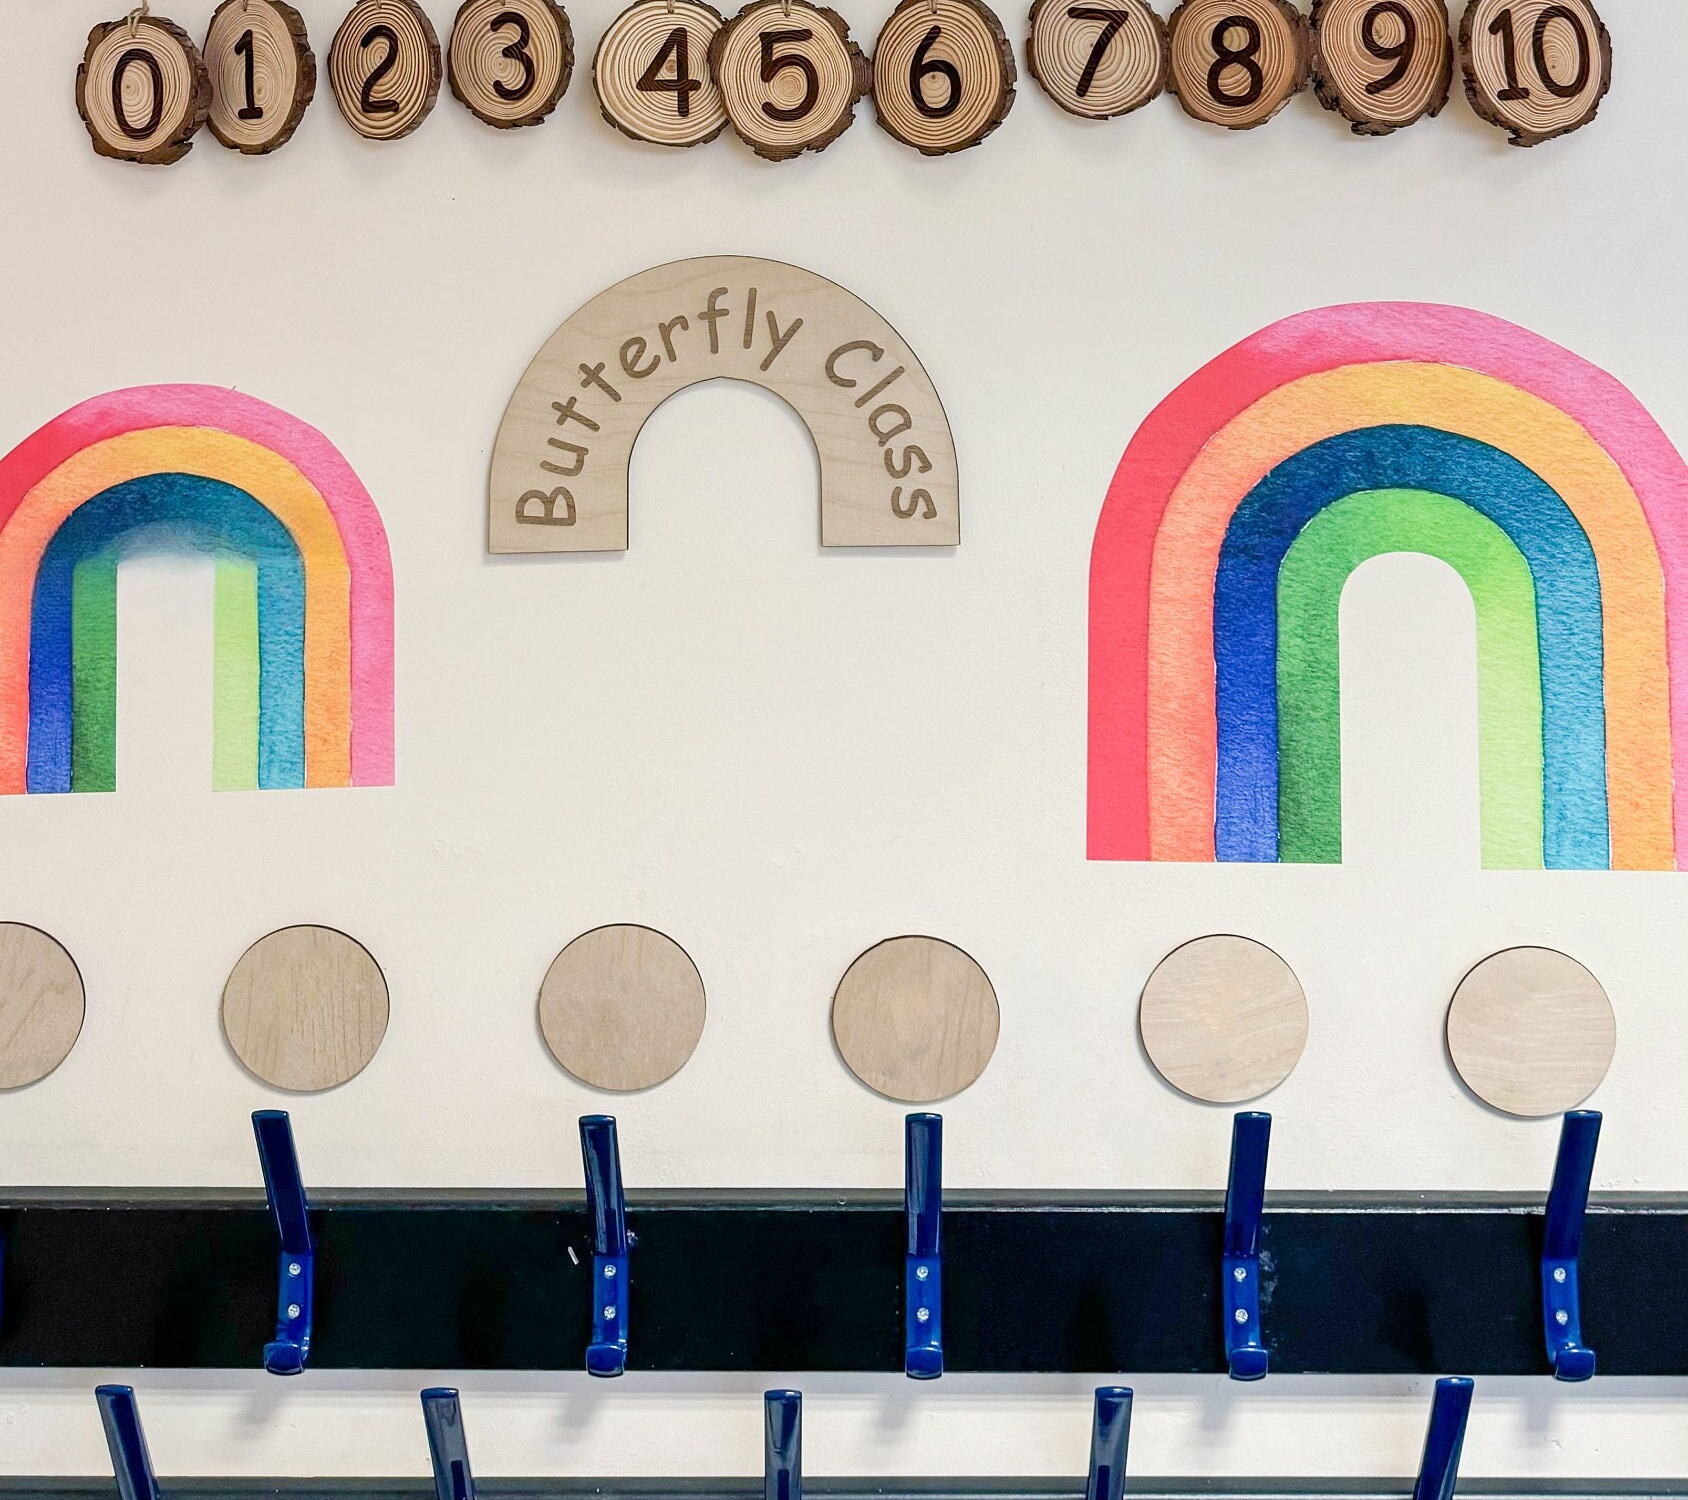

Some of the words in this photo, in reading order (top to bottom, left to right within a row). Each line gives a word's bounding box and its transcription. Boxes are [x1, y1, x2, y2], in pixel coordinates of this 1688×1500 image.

[112, 48, 164, 140] 0
[234, 29, 264, 120] 1
[360, 24, 400, 113] 2
[489, 11, 537, 101] 3
[636, 27, 701, 117] 4
[758, 29, 820, 121] 5
[909, 25, 962, 118] 6
[1067, 7, 1129, 98] 7
[1206, 15, 1263, 107] 8
[1362, 1, 1416, 95] 9
[1488, 4, 1589, 101] 10
[515, 287, 803, 527] Butterfly
[825, 339, 937, 521] Class
